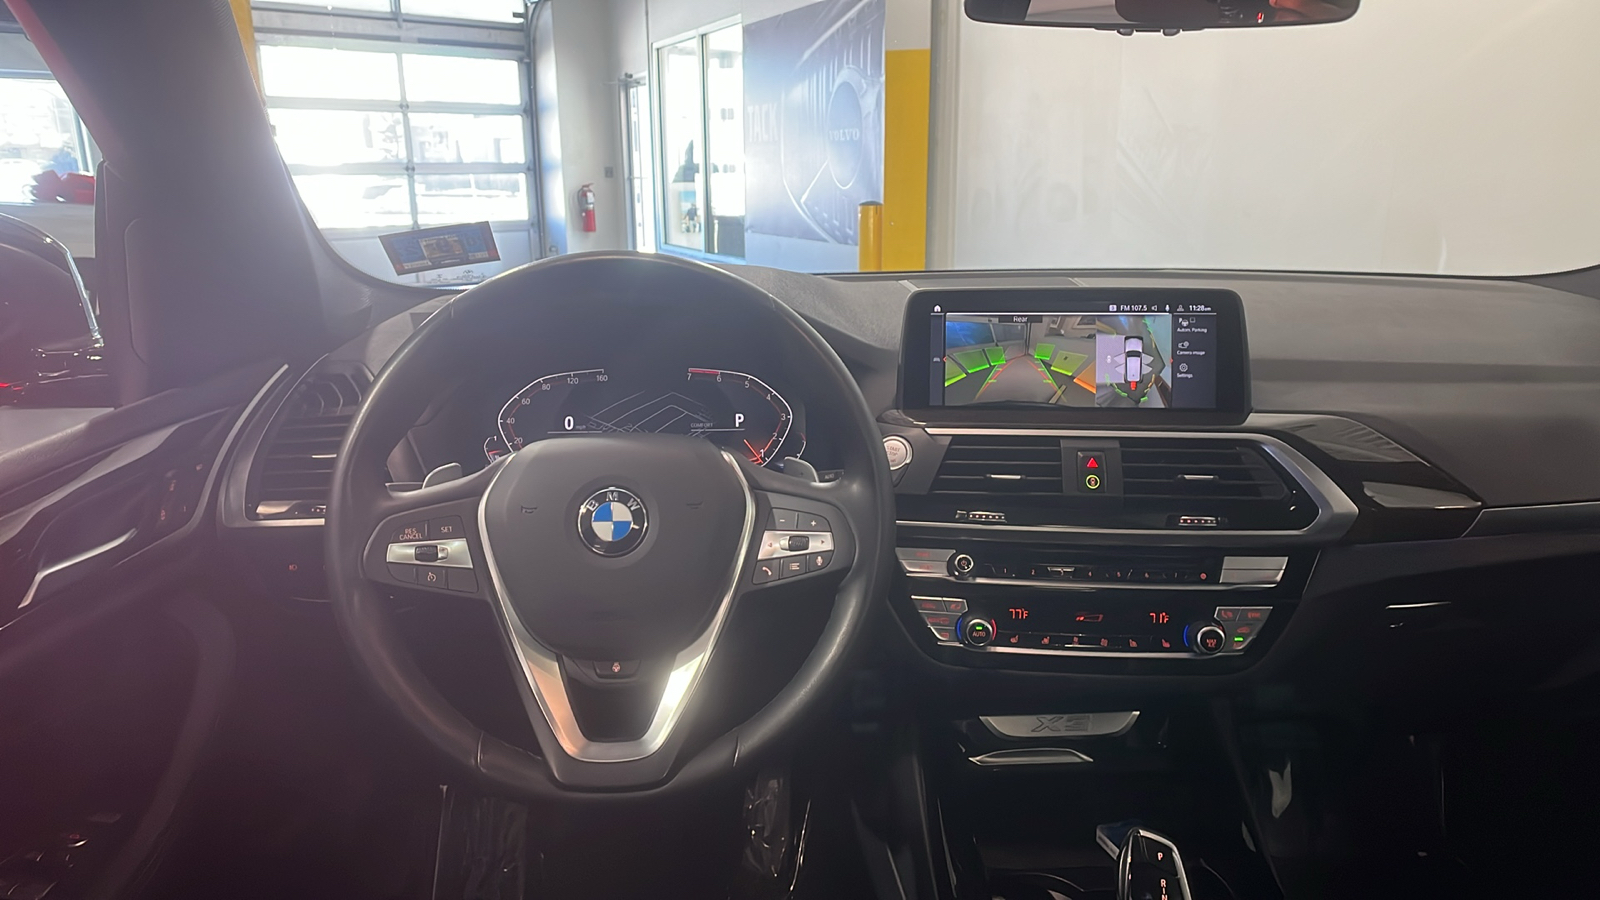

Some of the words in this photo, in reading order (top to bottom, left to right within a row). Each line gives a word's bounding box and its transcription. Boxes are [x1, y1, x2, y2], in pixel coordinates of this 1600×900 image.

[829, 128, 860, 141] VOLVO
[1013, 315, 1028, 323] Rear
[597, 374, 608, 382] 160
[716, 374, 722, 382] 6
[541, 383, 551, 391] 80
[744, 380, 750, 388] 5
[564, 416, 574, 430] 0
[735, 413, 744, 427] P
[772, 432, 778, 440] 2
[759, 448, 764, 457] 1
[586, 491, 641, 511] BMW
[440, 525, 453, 533] SET
[972, 630, 986, 638] AUTO
[1031, 715, 1090, 732] X3
[1157, 852, 1163, 861] P
[1160, 878, 1167, 888] R
